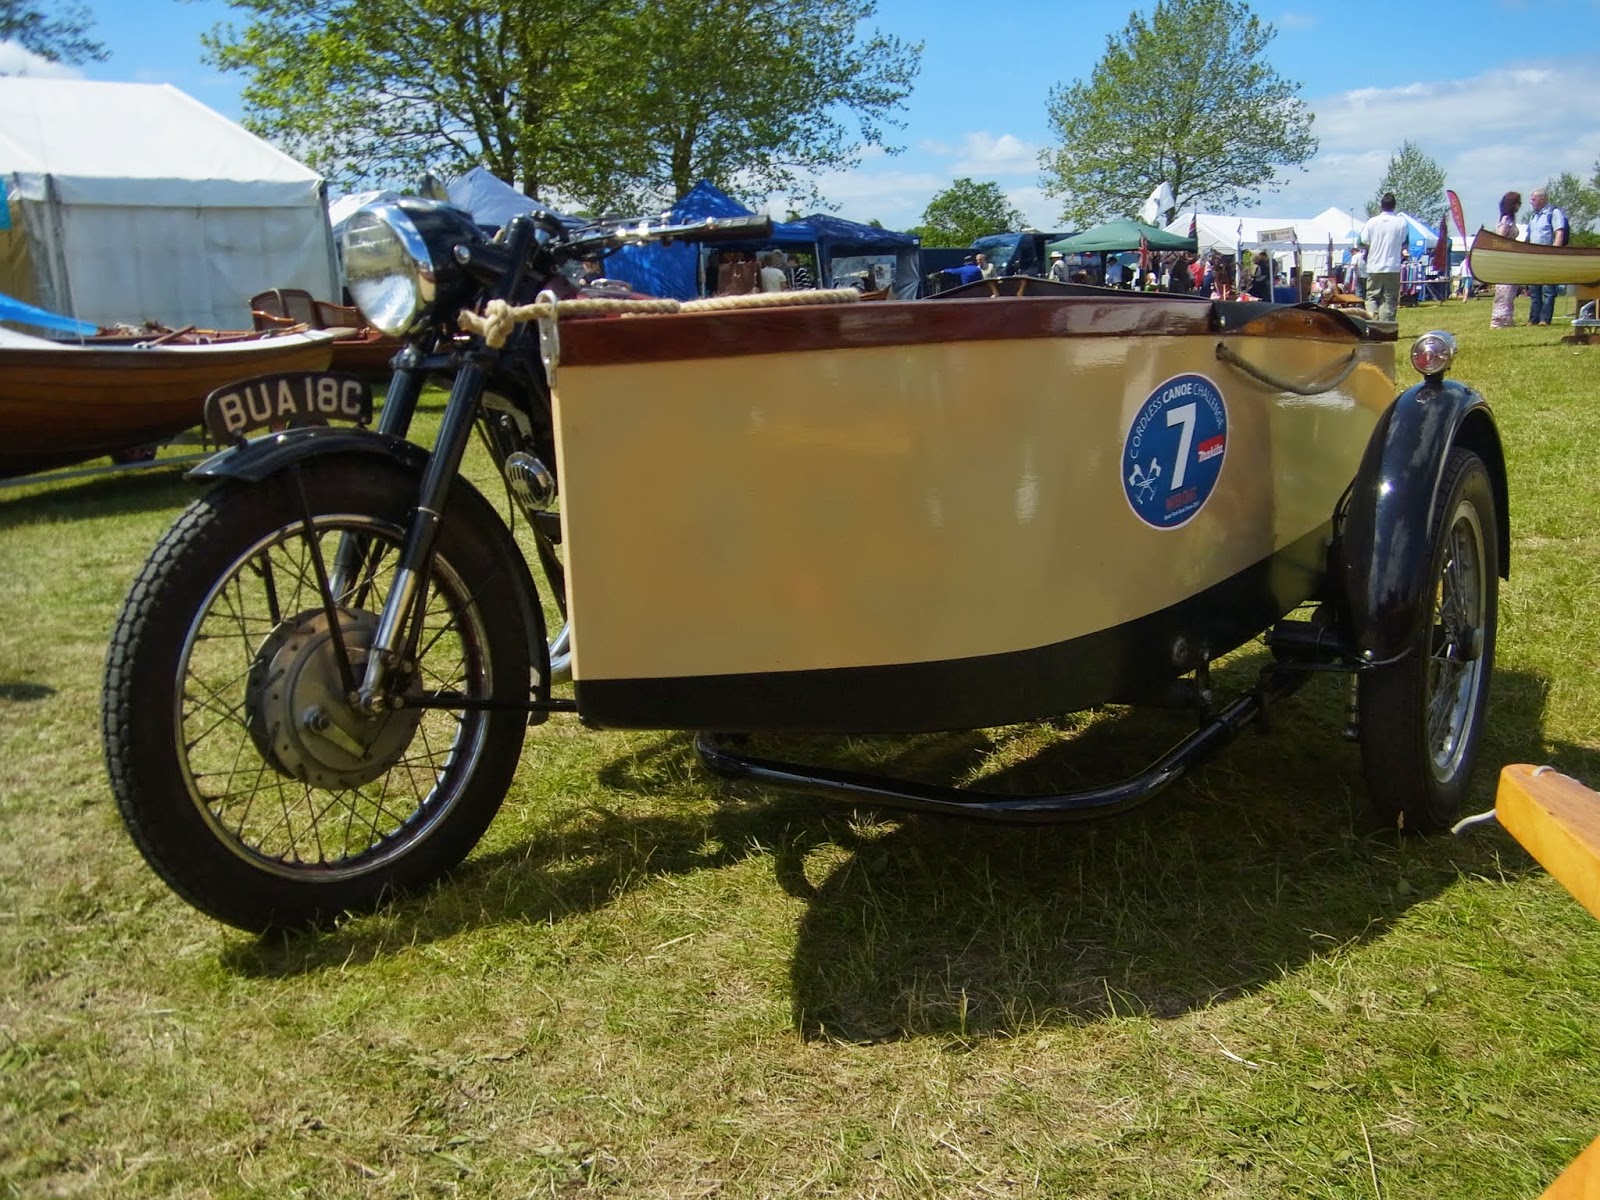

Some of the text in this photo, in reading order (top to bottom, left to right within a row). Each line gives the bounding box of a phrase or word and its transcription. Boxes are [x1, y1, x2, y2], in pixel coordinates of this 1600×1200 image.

[218, 377, 362, 432] BUA 18C
[1130, 382, 1224, 459] CORDLESS CANOE CHALLENGE
[1166, 401, 1197, 491] 7
